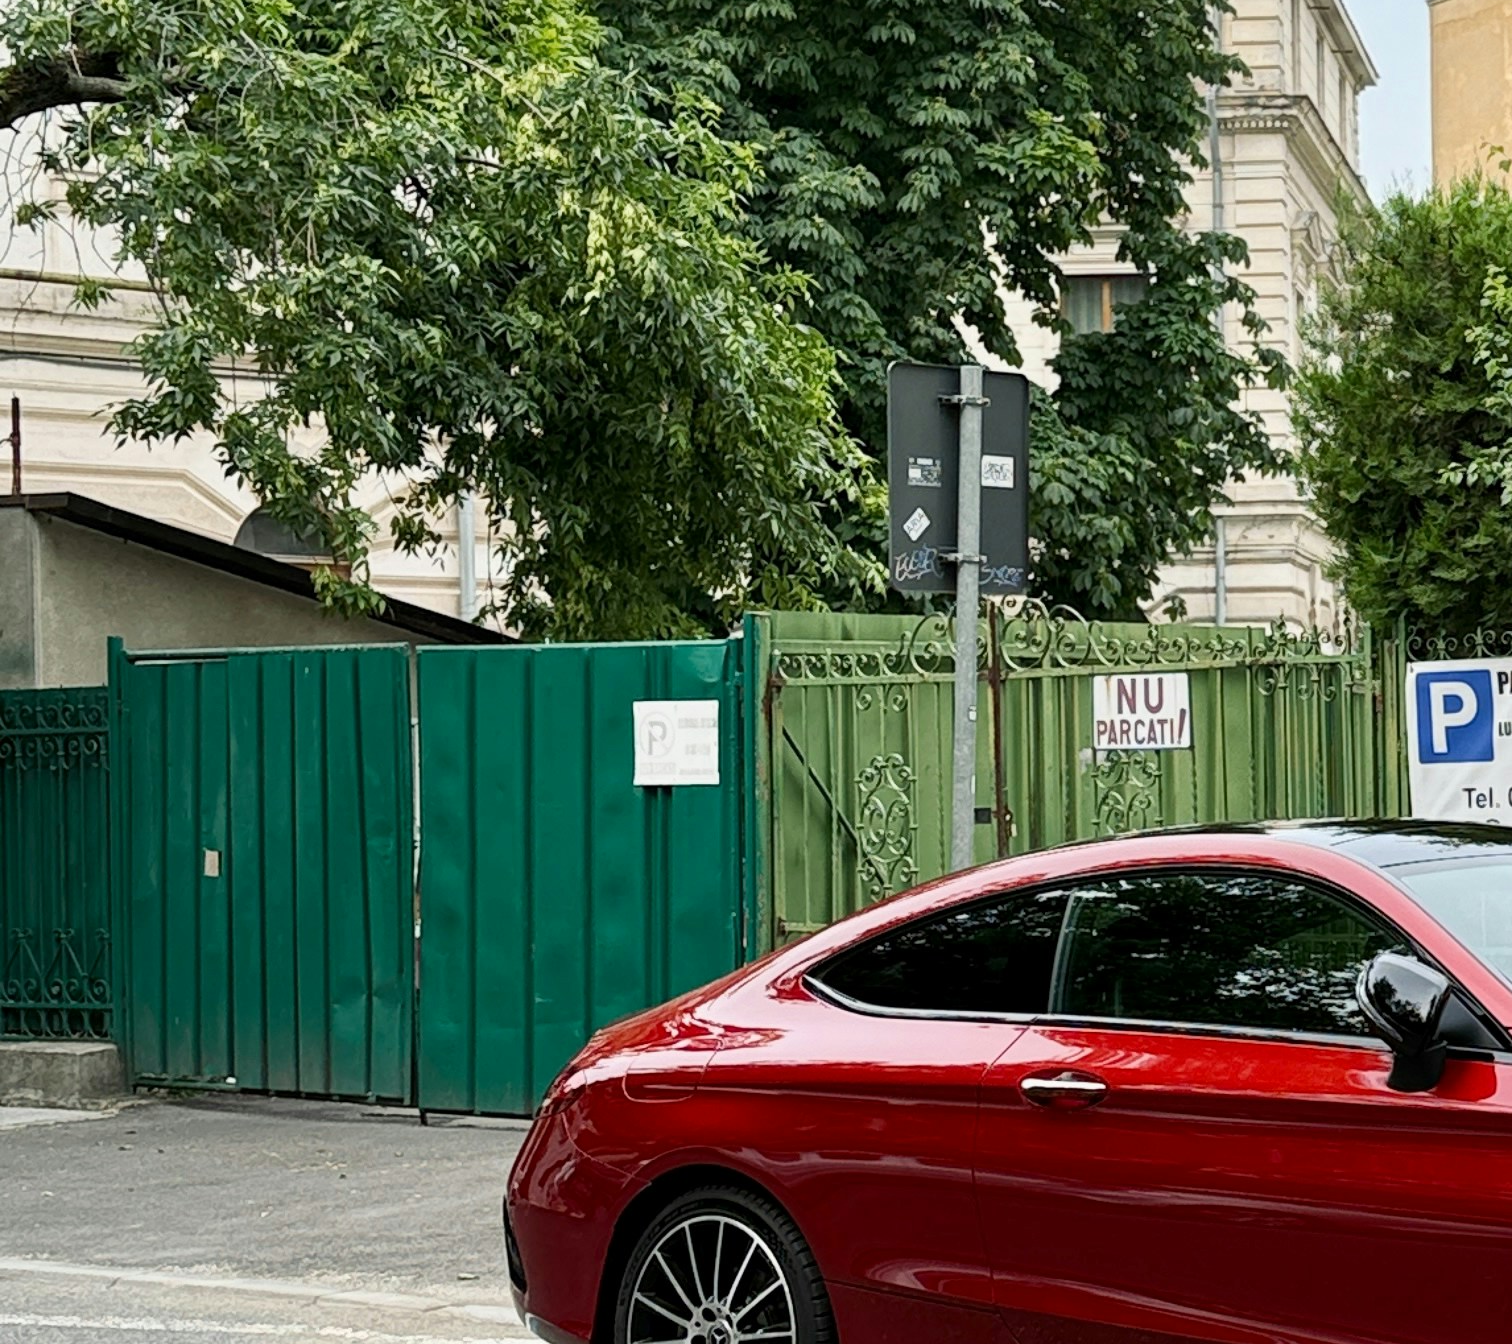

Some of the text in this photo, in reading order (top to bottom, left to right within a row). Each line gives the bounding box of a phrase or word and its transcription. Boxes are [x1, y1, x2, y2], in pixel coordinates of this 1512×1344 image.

[1117, 677, 1164, 715] NU
[1096, 708, 1187, 746] PARCATI!
[1429, 681, 1478, 754] P
[1462, 787, 1500, 808] Tel.
